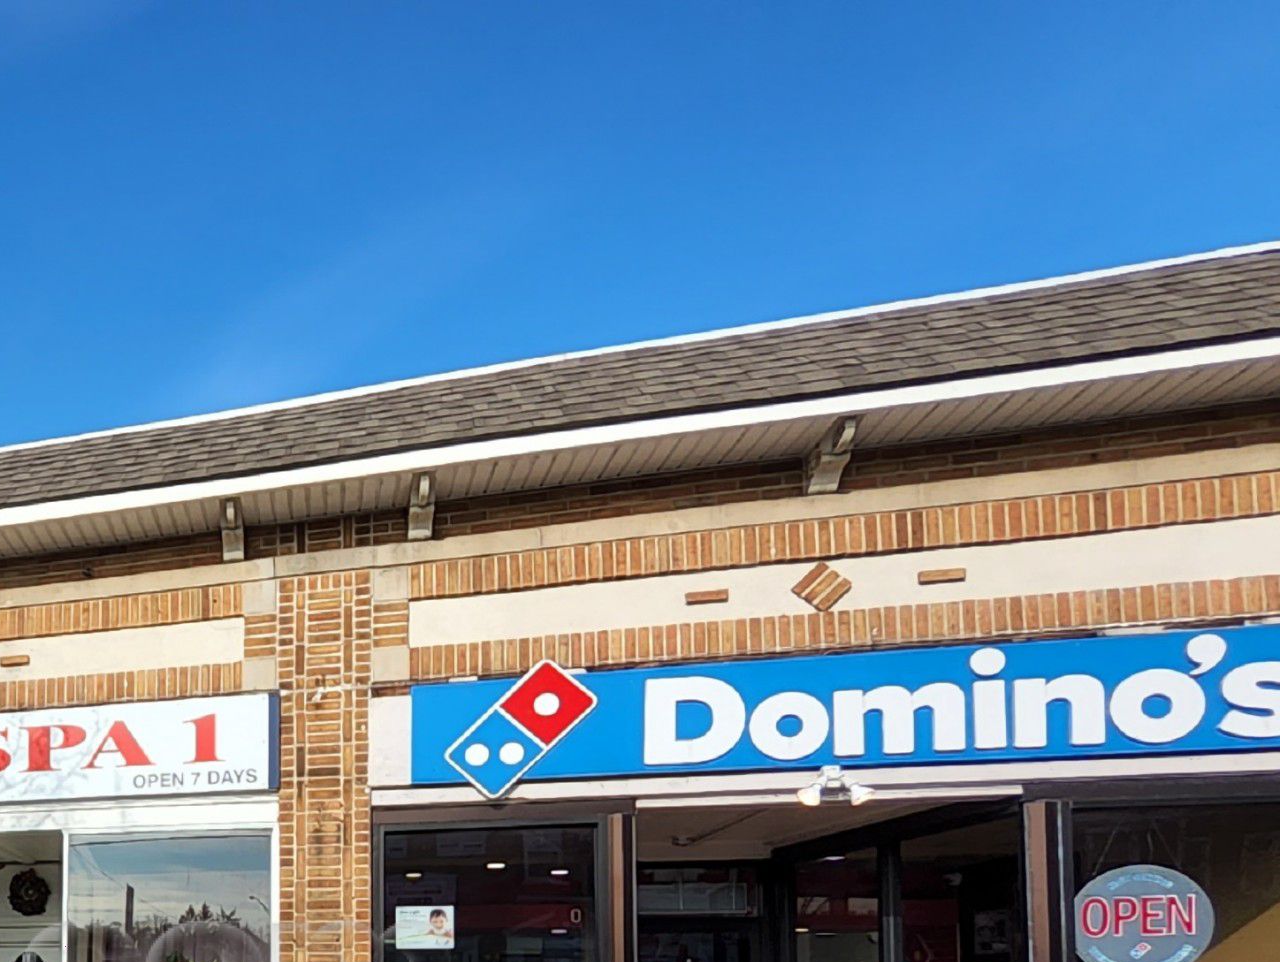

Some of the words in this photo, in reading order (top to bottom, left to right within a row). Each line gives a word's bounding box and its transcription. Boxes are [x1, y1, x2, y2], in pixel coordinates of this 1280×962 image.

[643, 633, 1280, 766] Domino's
[183, 713, 225, 764] 1
[132, 772, 185, 789] OPEN
[190, 771, 201, 786] 7
[207, 768, 258, 786] DAYS
[1081, 893, 1197, 939] OPEN
